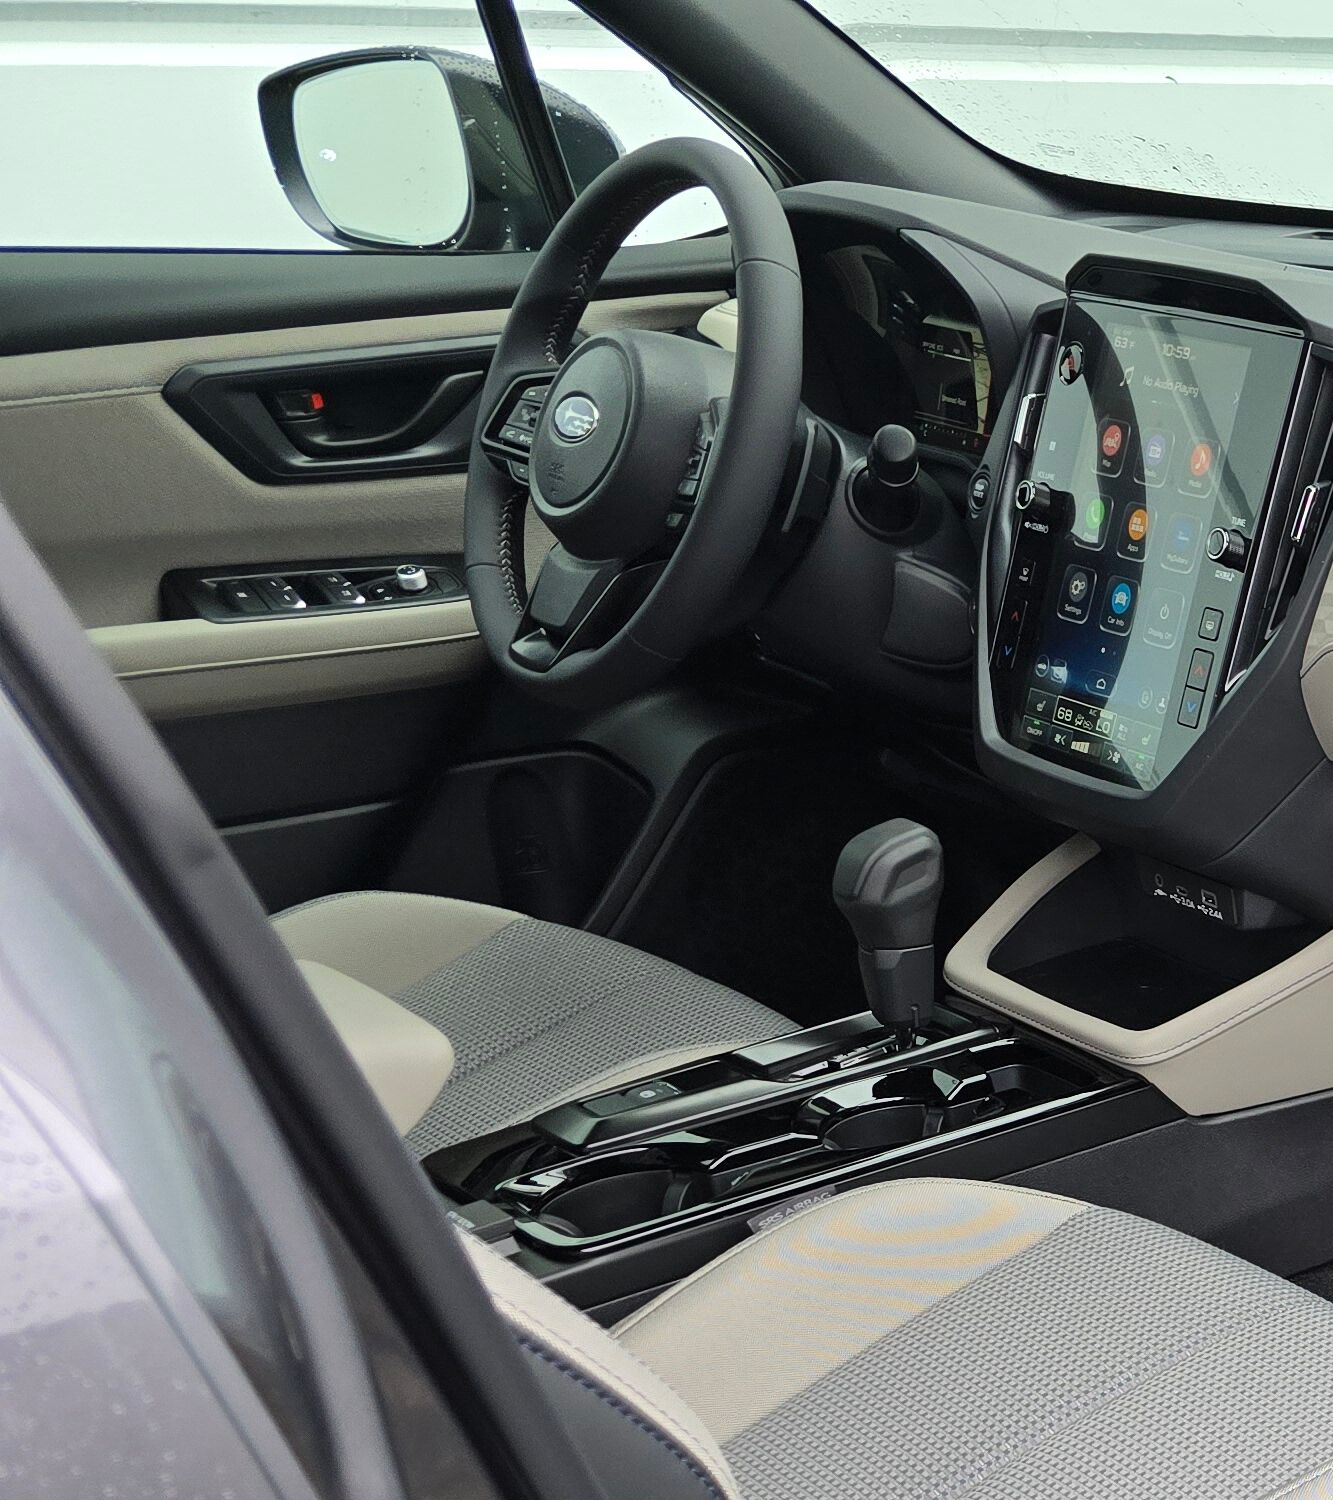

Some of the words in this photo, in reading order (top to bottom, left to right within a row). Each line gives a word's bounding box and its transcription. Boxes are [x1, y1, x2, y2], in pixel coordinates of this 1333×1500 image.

[1162, 343, 1191, 360] 10:59
[1142, 375, 1153, 387] No
[1174, 381, 1200, 399] Playing
[1127, 543, 1139, 553] Apps
[1057, 707, 1073, 722] 68
[785, 1192, 833, 1217] AIRBAG
